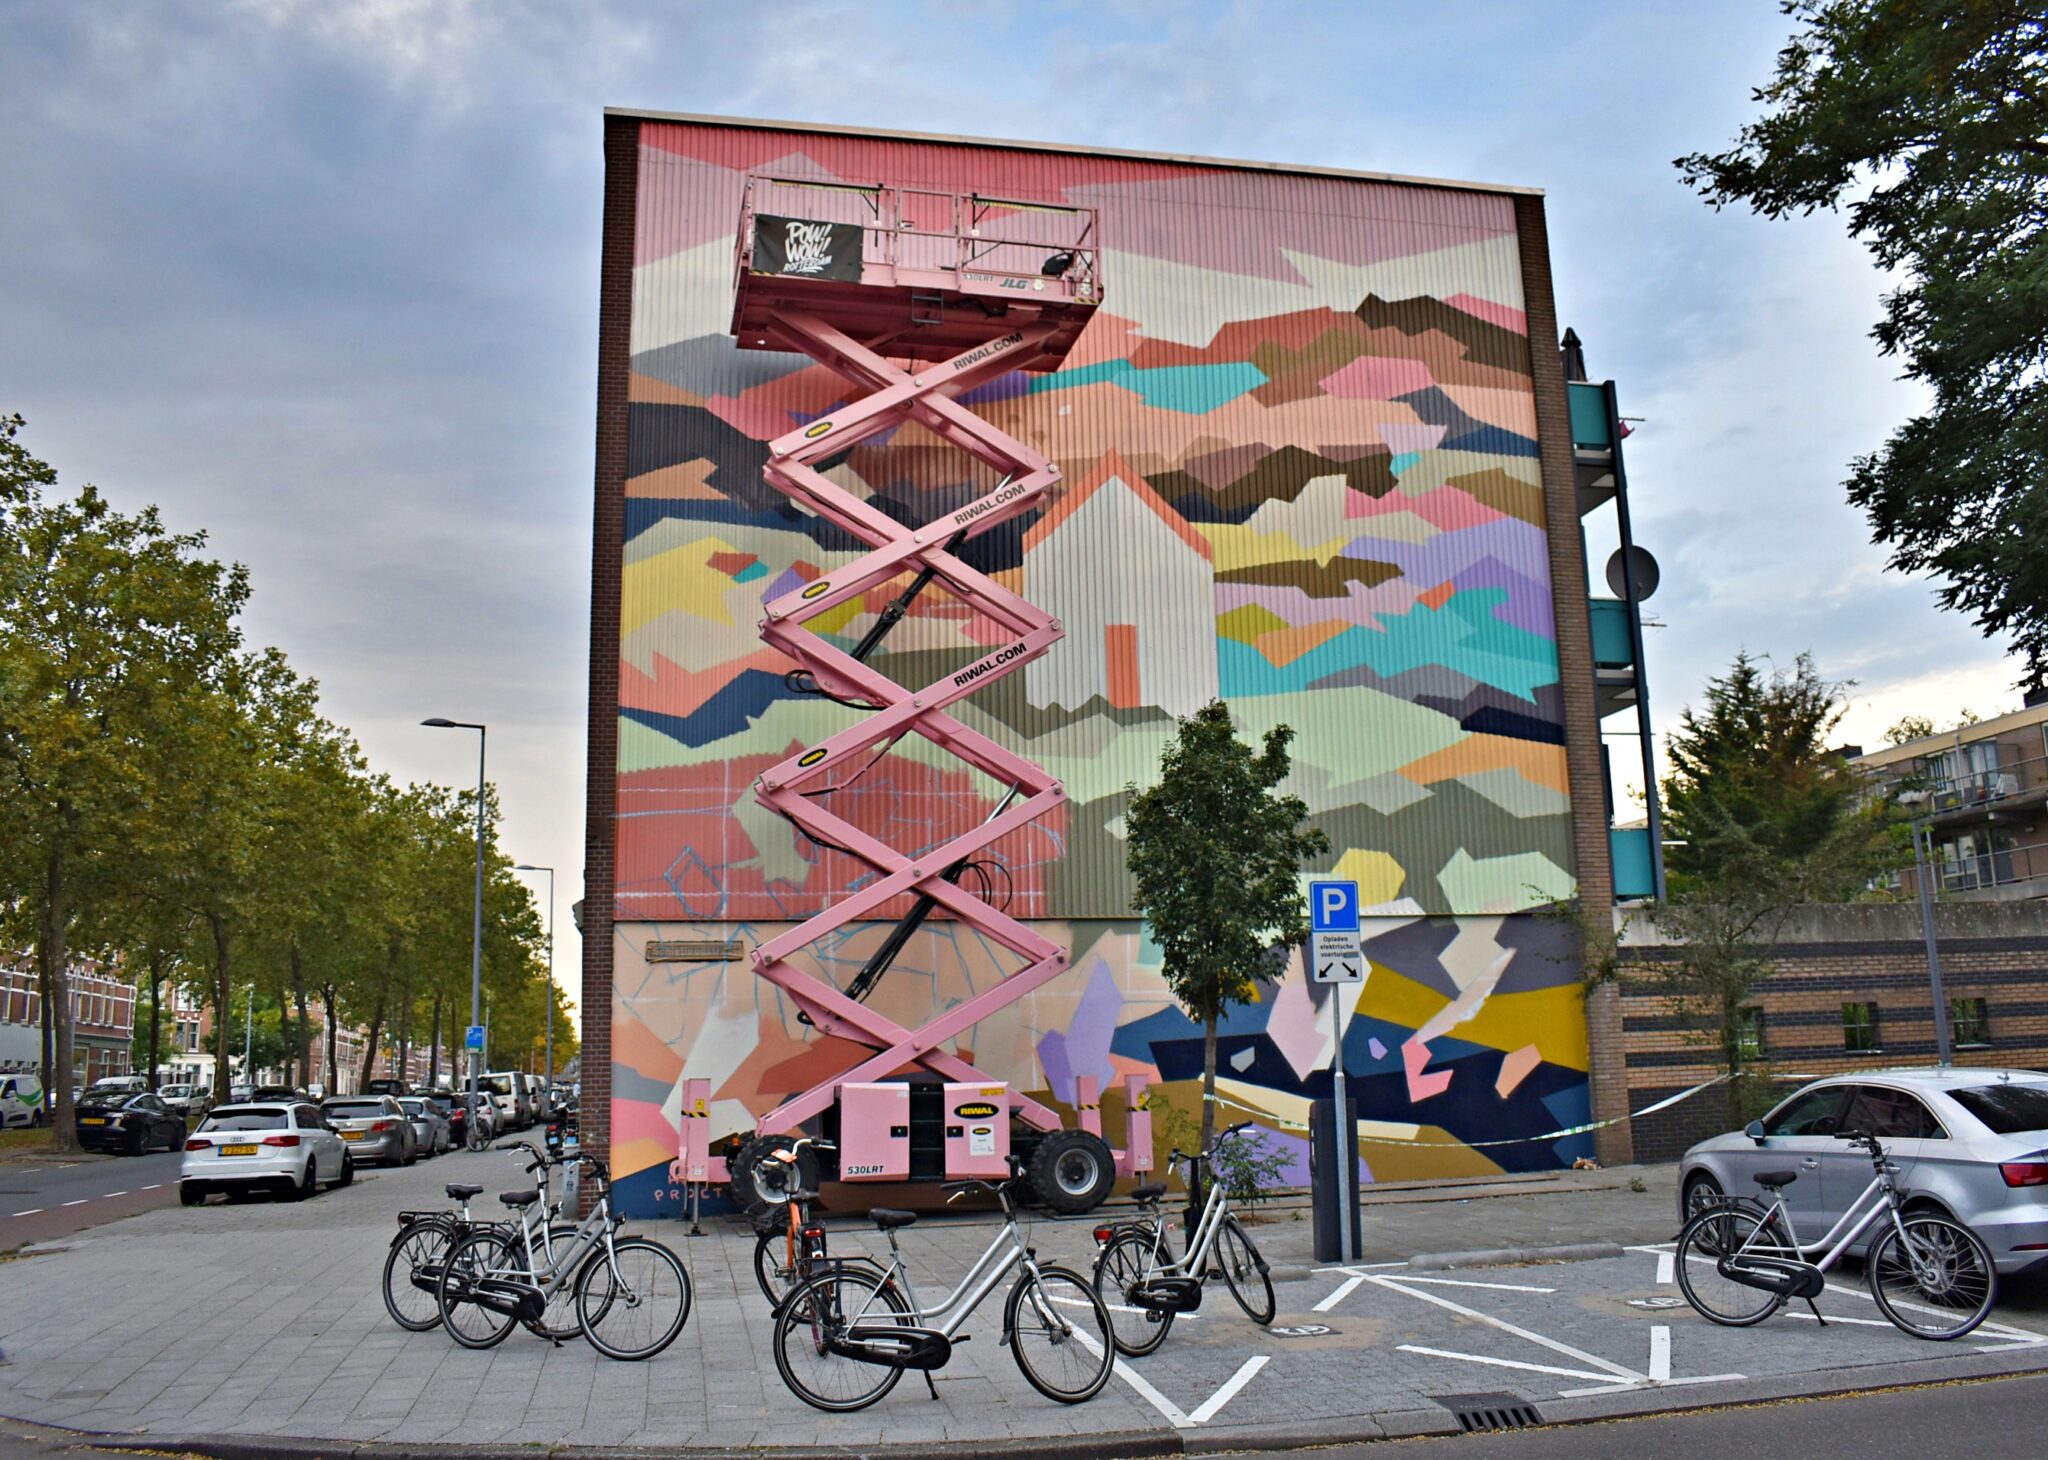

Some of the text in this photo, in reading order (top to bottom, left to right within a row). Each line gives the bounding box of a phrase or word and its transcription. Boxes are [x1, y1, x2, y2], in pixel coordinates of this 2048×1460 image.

[785, 222, 832, 244] POW!
[785, 237, 832, 262] WOW!
[999, 278, 1028, 290] JLG
[953, 331, 1024, 370] RIWAL.COM
[954, 484, 1026, 525] RIWAL.COM
[953, 642, 1027, 687] RIWAL.COM
[1322, 888, 1347, 925] P
[1323, 935, 1348, 943] Opladen
[960, 1107, 994, 1115] RIWAL
[847, 1165, 885, 1174] 530LRT
